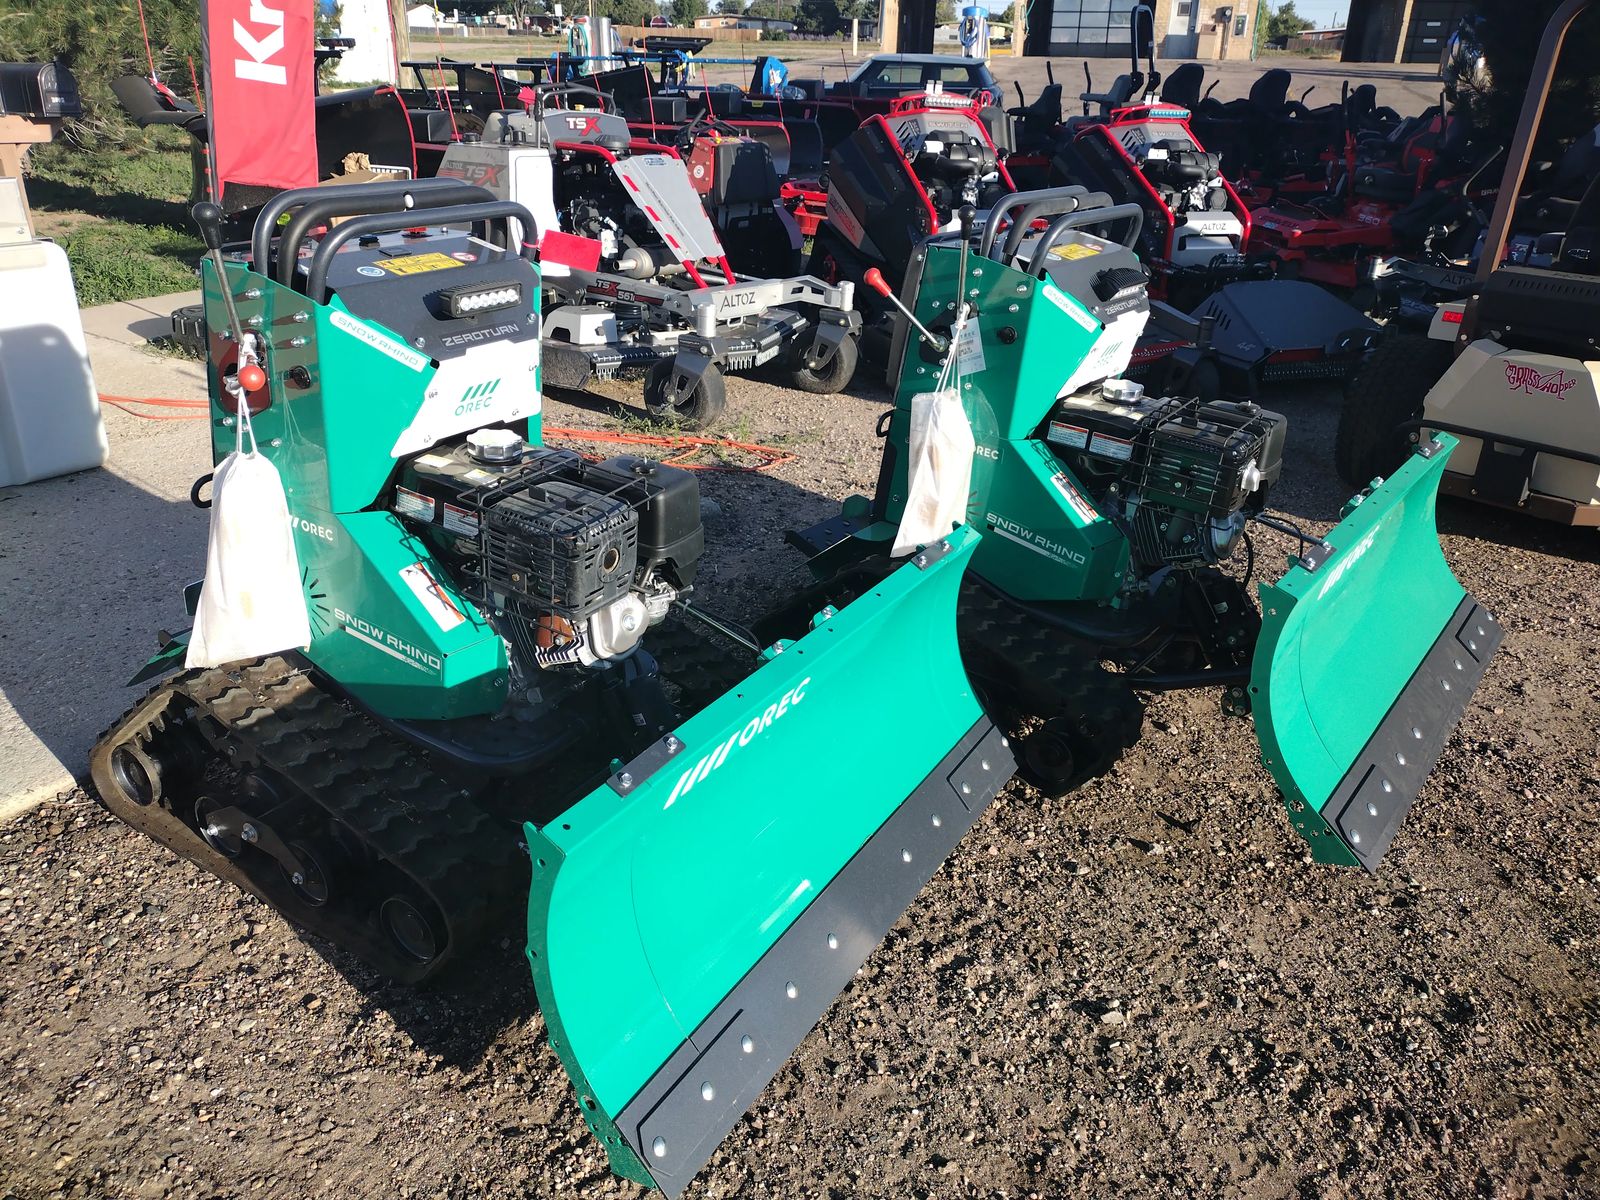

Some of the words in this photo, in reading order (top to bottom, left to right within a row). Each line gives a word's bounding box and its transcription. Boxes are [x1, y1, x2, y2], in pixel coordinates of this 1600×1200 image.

[565, 117, 602, 137] TSX
[465, 164, 500, 188] TSX
[1200, 222, 1227, 237] ALTOZ
[594, 279, 620, 296] TSX
[1439, 273, 1475, 287] ALTO
[720, 291, 756, 313] ALTOZ
[1104, 298, 1140, 315] ZEROTURN
[336, 316, 377, 342] SNOW
[378, 339, 419, 366] RHINO
[441, 323, 520, 348] ZEROTURN
[454, 396, 493, 417] OREC
[301, 520, 334, 541] OREC
[986, 512, 1033, 540] SNOW
[1034, 535, 1086, 565] RHINO
[334, 608, 384, 641] SNOW
[386, 633, 442, 670] RHINO
[738, 676, 812, 748] OREC
